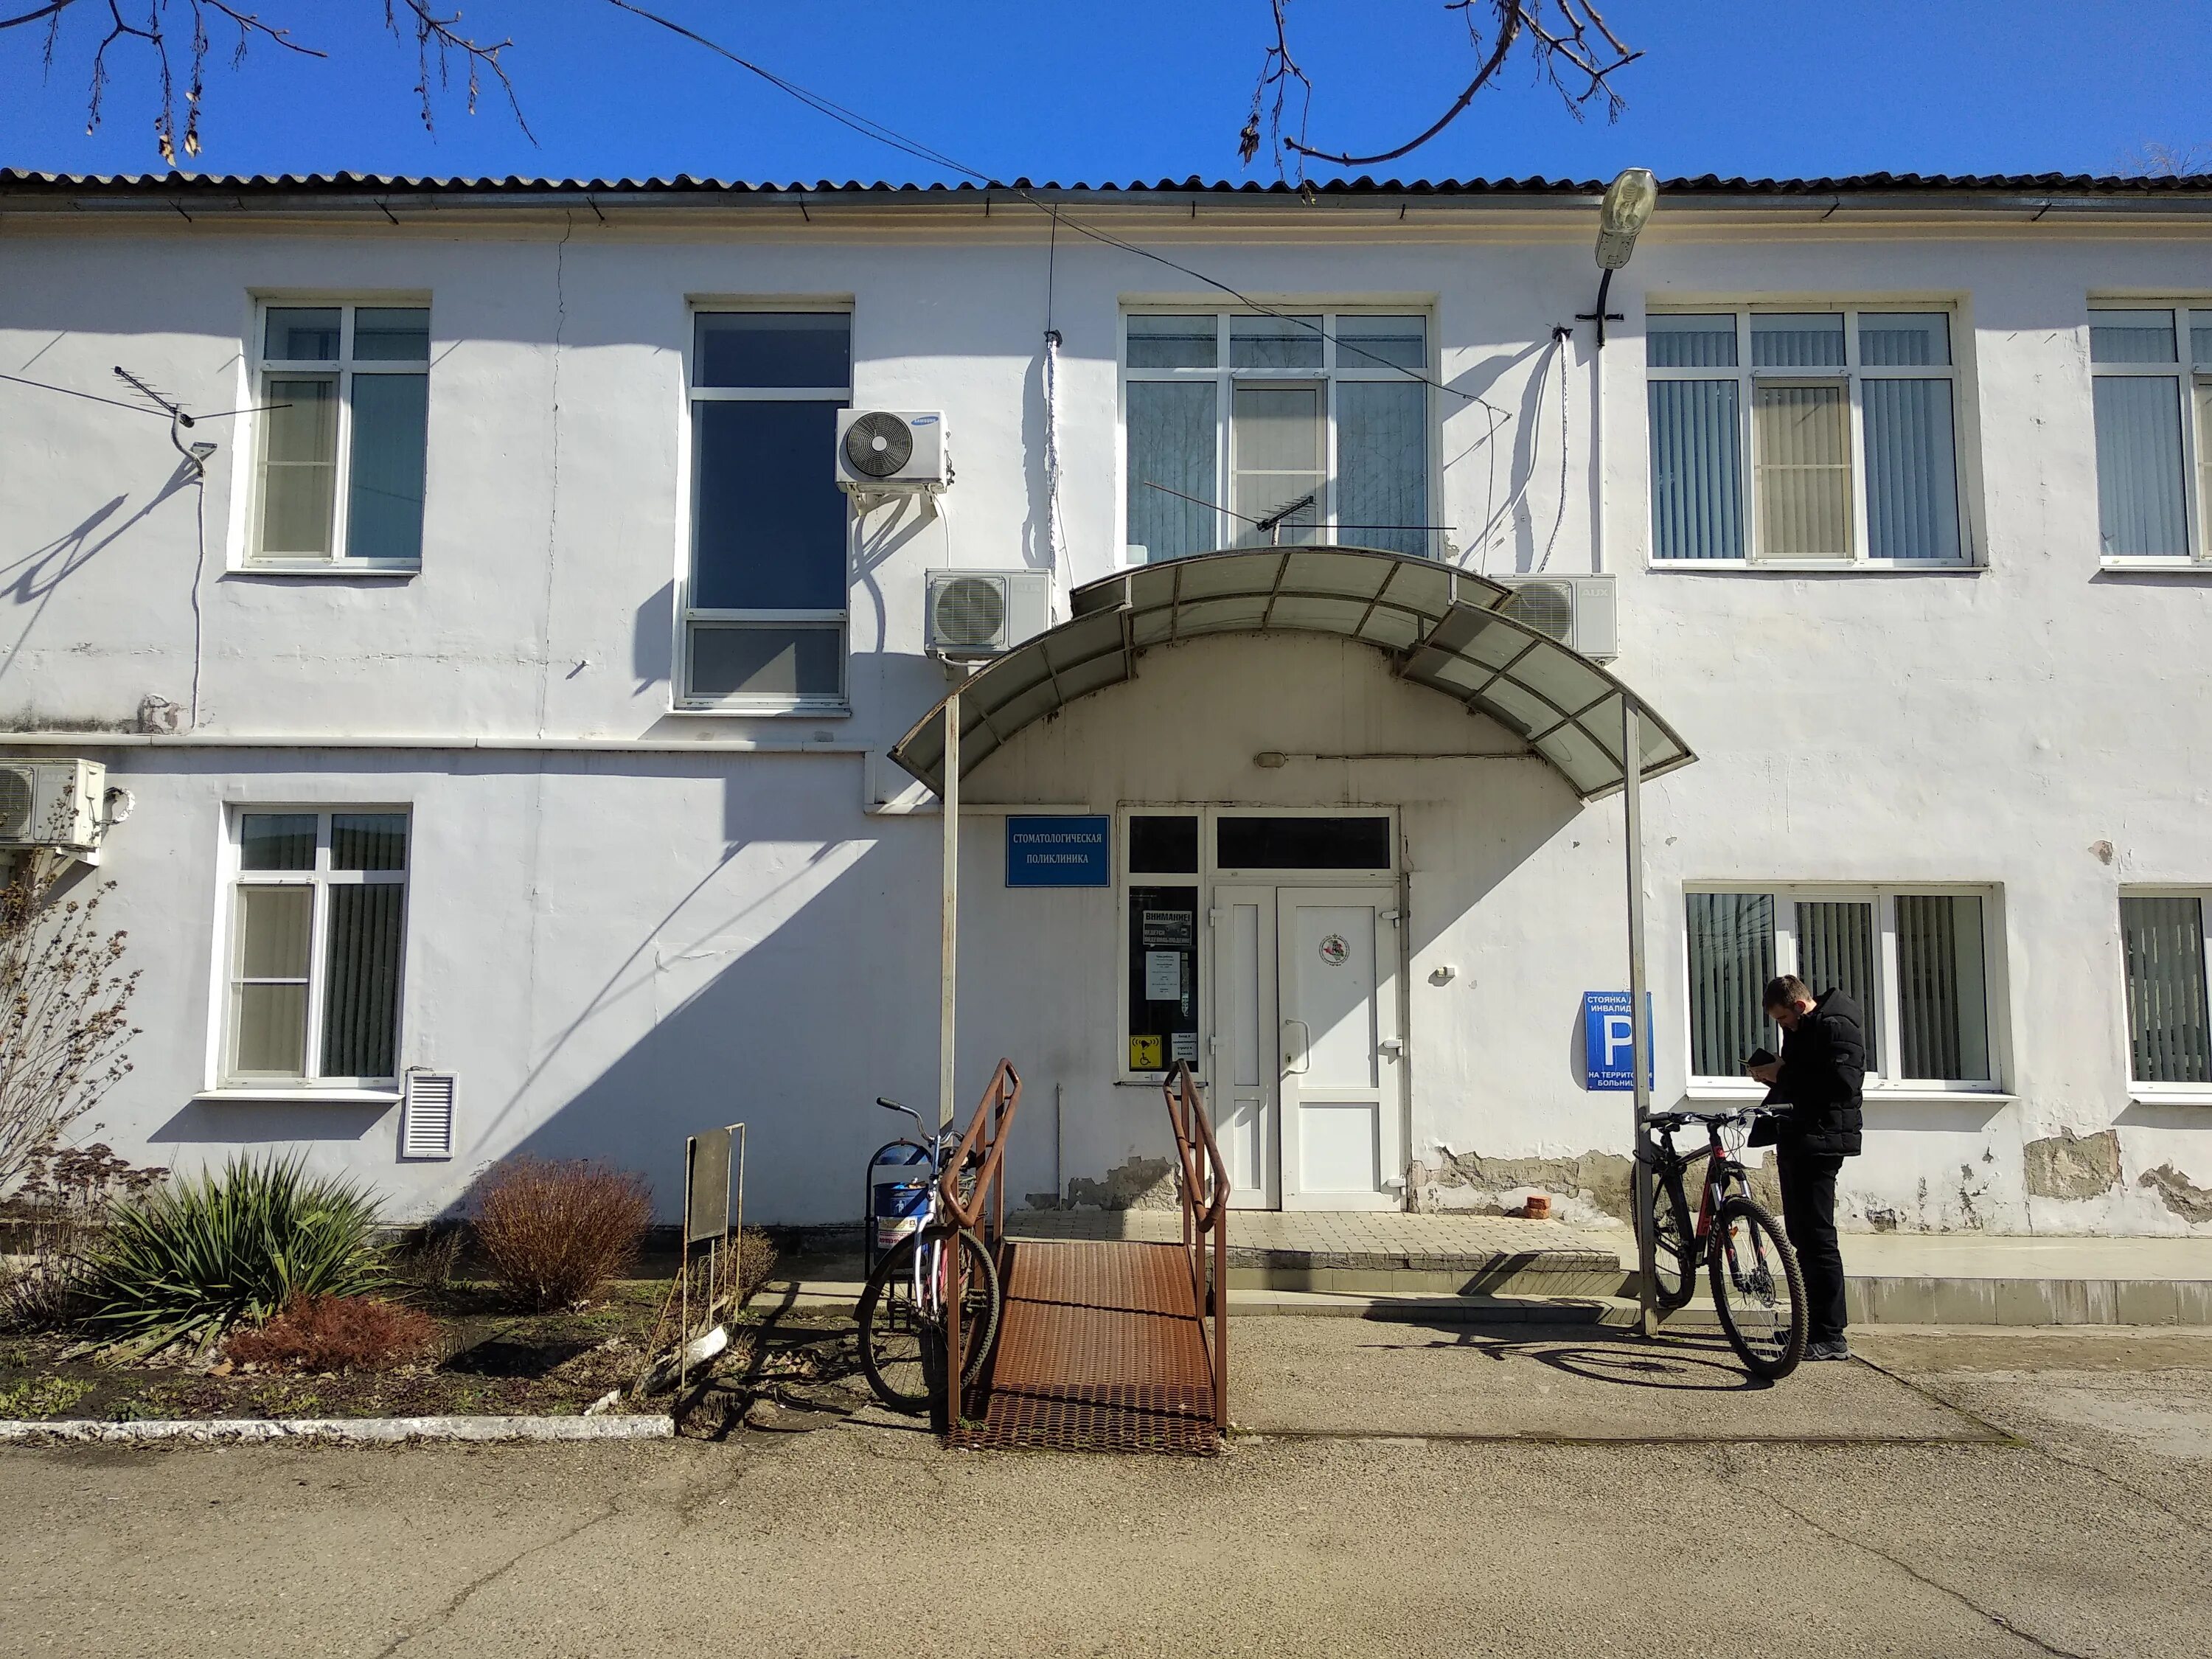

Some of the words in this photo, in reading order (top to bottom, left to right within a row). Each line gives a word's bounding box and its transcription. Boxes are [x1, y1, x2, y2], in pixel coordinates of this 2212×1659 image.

[1013, 833, 1102, 844] СТОМАТОЛОГИЧЕСКАЯ
[1026, 854, 1088, 863] ПОЛИКЛИНИКА
[1604, 1015, 1632, 1065] P
